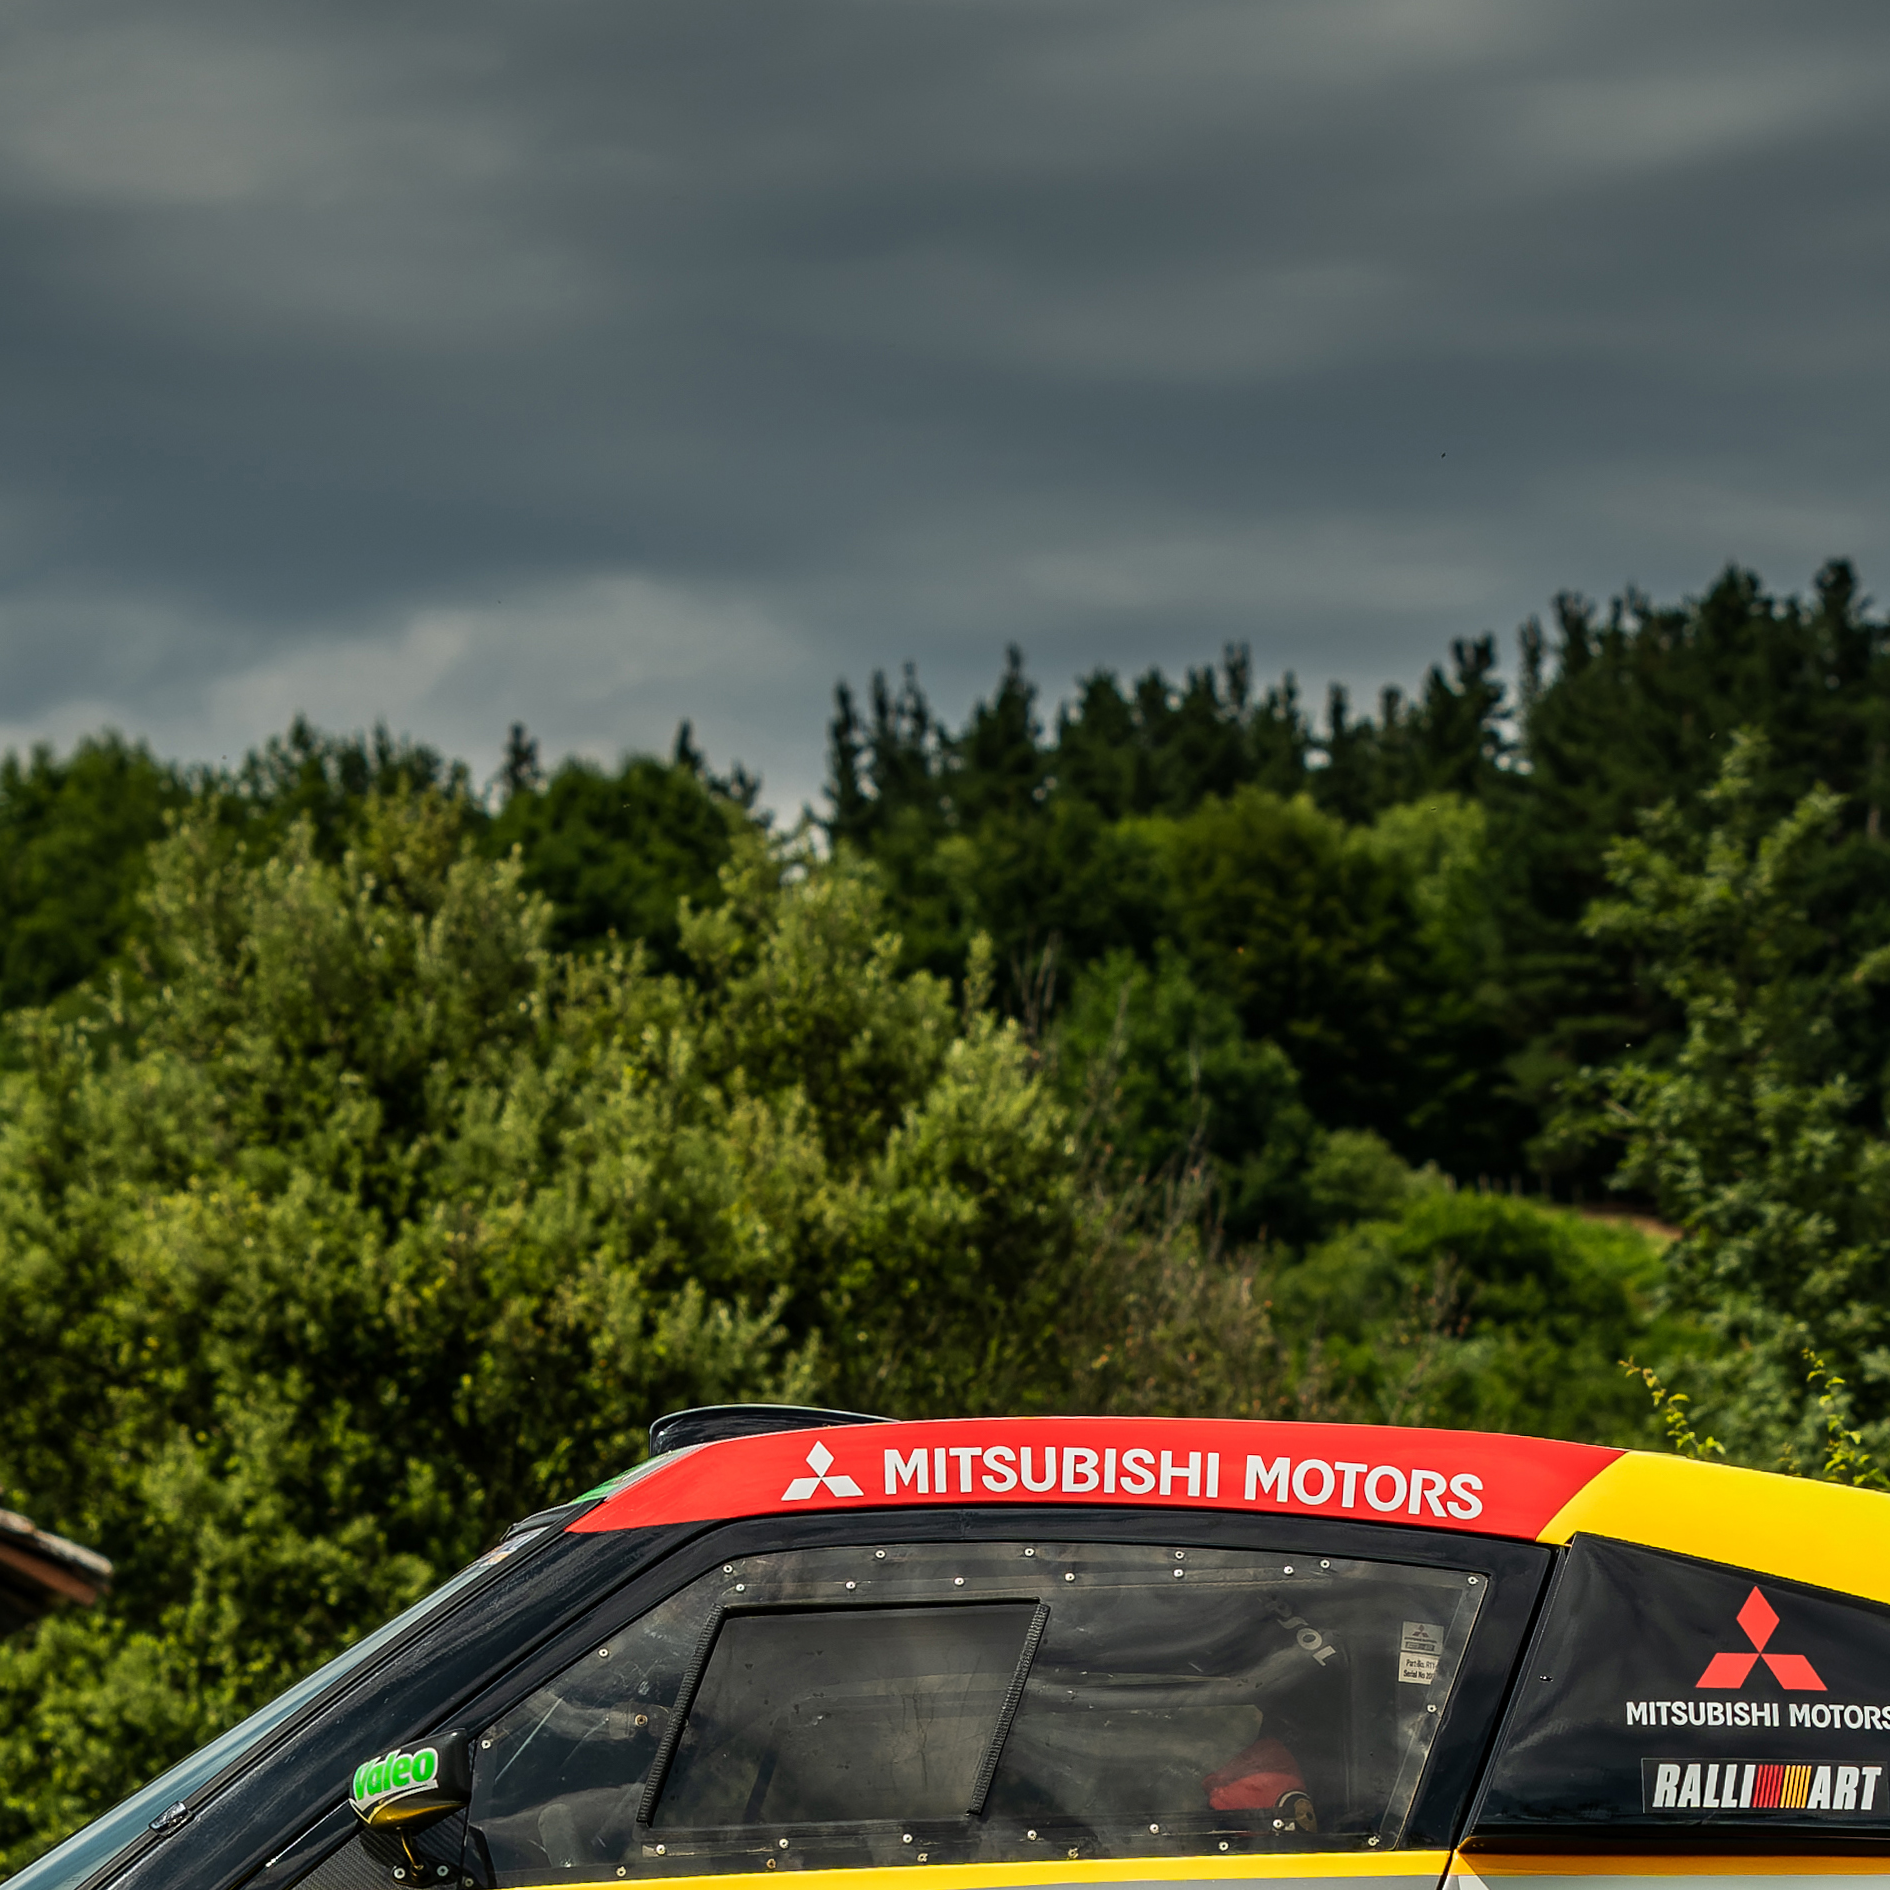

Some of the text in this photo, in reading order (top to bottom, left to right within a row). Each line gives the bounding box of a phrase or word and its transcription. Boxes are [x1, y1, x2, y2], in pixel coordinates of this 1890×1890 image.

[883, 1445, 1484, 1520] MITSUBISHI MOTORS
[1625, 1701, 1780, 1727] MITSUBISHI
[354, 1750, 437, 1801] Valeo
[1652, 1763, 1883, 1811] RALLI ART
